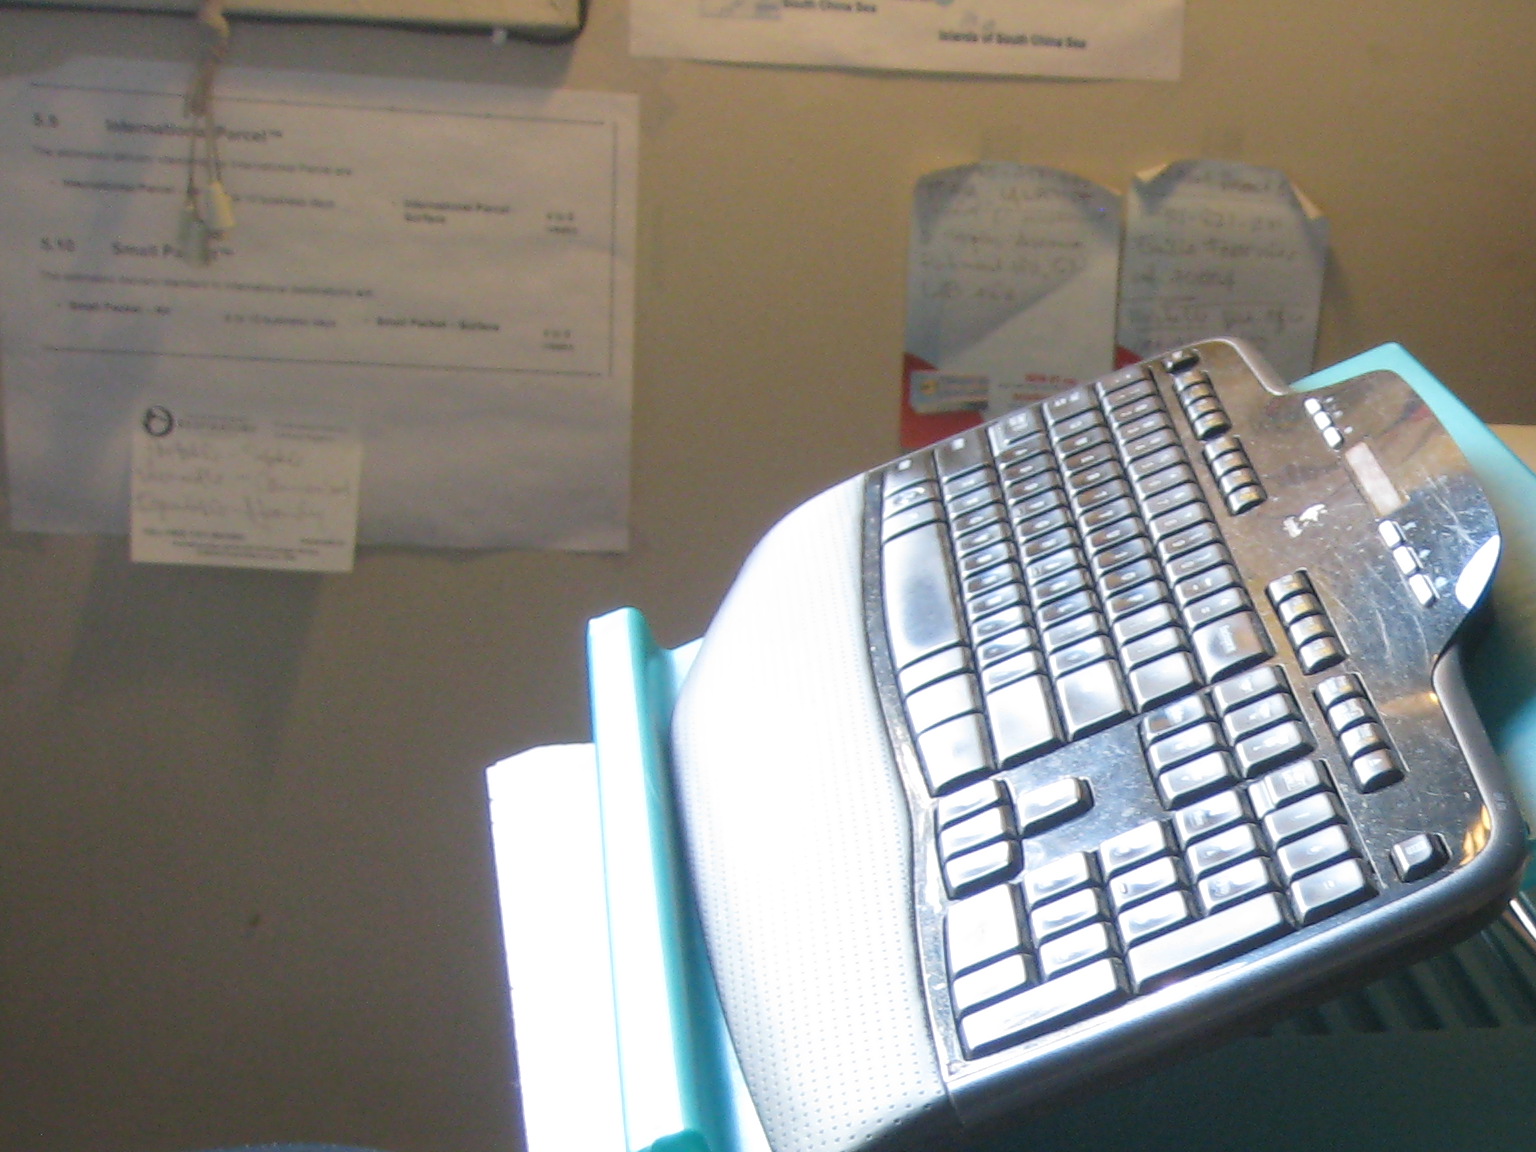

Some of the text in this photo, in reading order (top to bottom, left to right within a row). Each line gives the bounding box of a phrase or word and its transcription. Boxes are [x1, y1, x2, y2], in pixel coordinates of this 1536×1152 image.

[939, 29, 979, 42] Islands
[996, 33, 1028, 45] South
[1031, 34, 1063, 47] China
[1066, 36, 1087, 48] Sea
